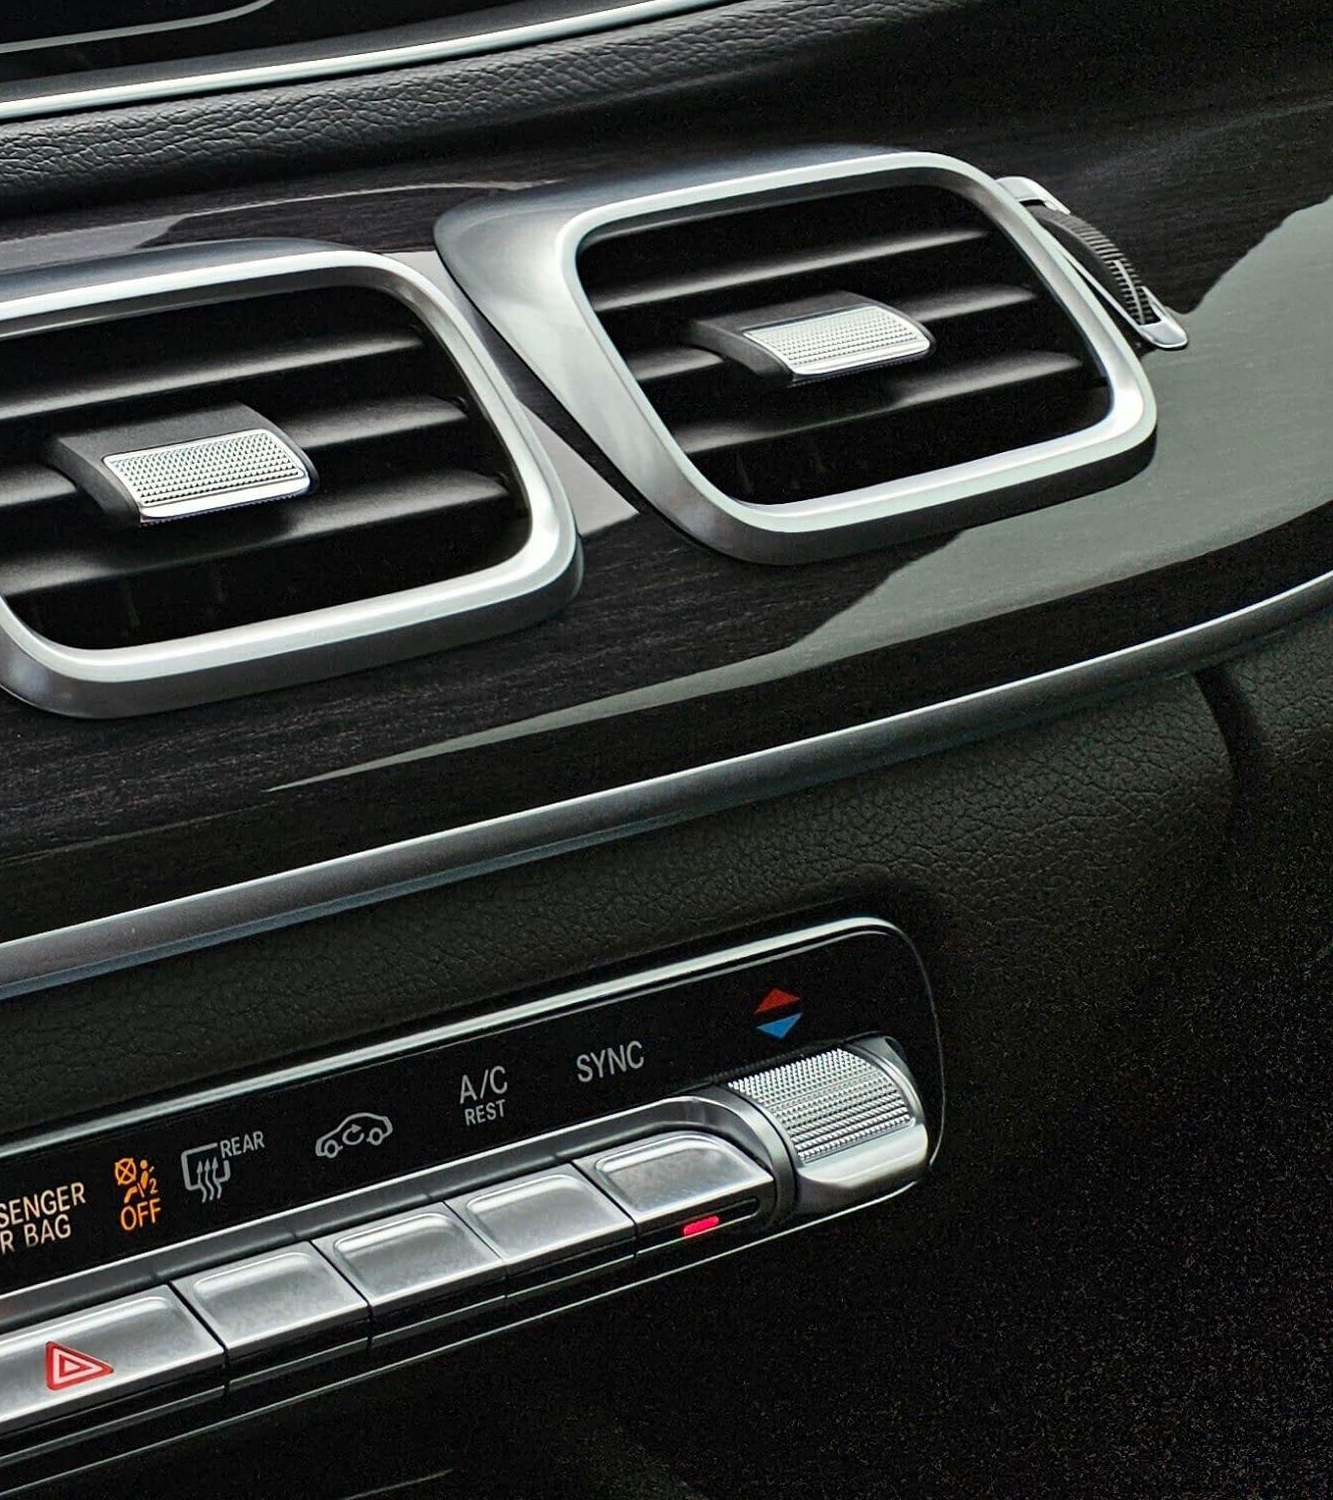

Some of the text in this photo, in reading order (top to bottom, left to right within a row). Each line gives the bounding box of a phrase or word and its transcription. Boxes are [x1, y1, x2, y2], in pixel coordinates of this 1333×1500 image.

[576, 1040, 644, 1082] SYNC
[459, 1065, 508, 1104] A/C
[464, 1098, 507, 1126] REST
[220, 1130, 265, 1159] REAR
[23, 1213, 72, 1247] BAG
[120, 1197, 162, 1231] OFF
